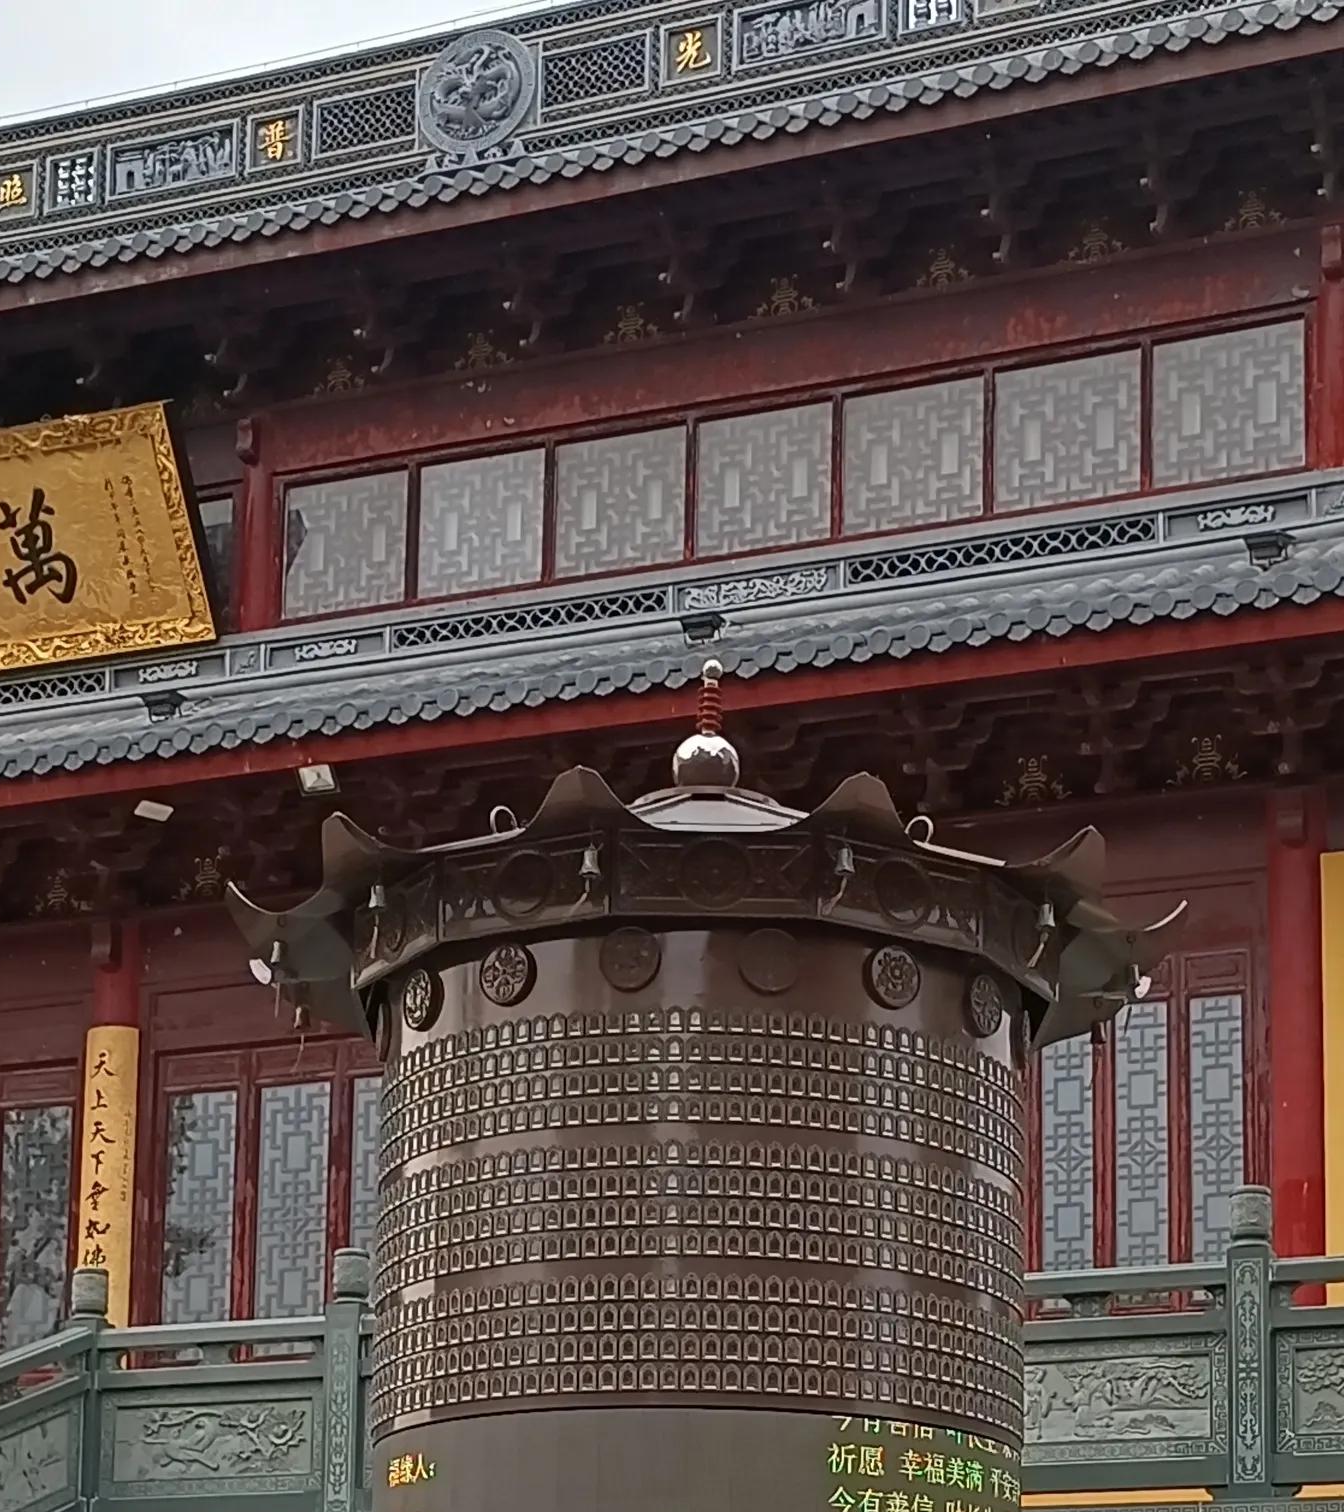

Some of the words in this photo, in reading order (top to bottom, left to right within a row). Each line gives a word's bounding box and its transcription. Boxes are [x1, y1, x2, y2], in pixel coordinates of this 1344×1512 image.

[675, 30, 712, 73] 光
[256, 120, 296, 160] 普
[827, 1443, 885, 1476] 祈愿
[899, 1449, 984, 1493] 幸福美满
